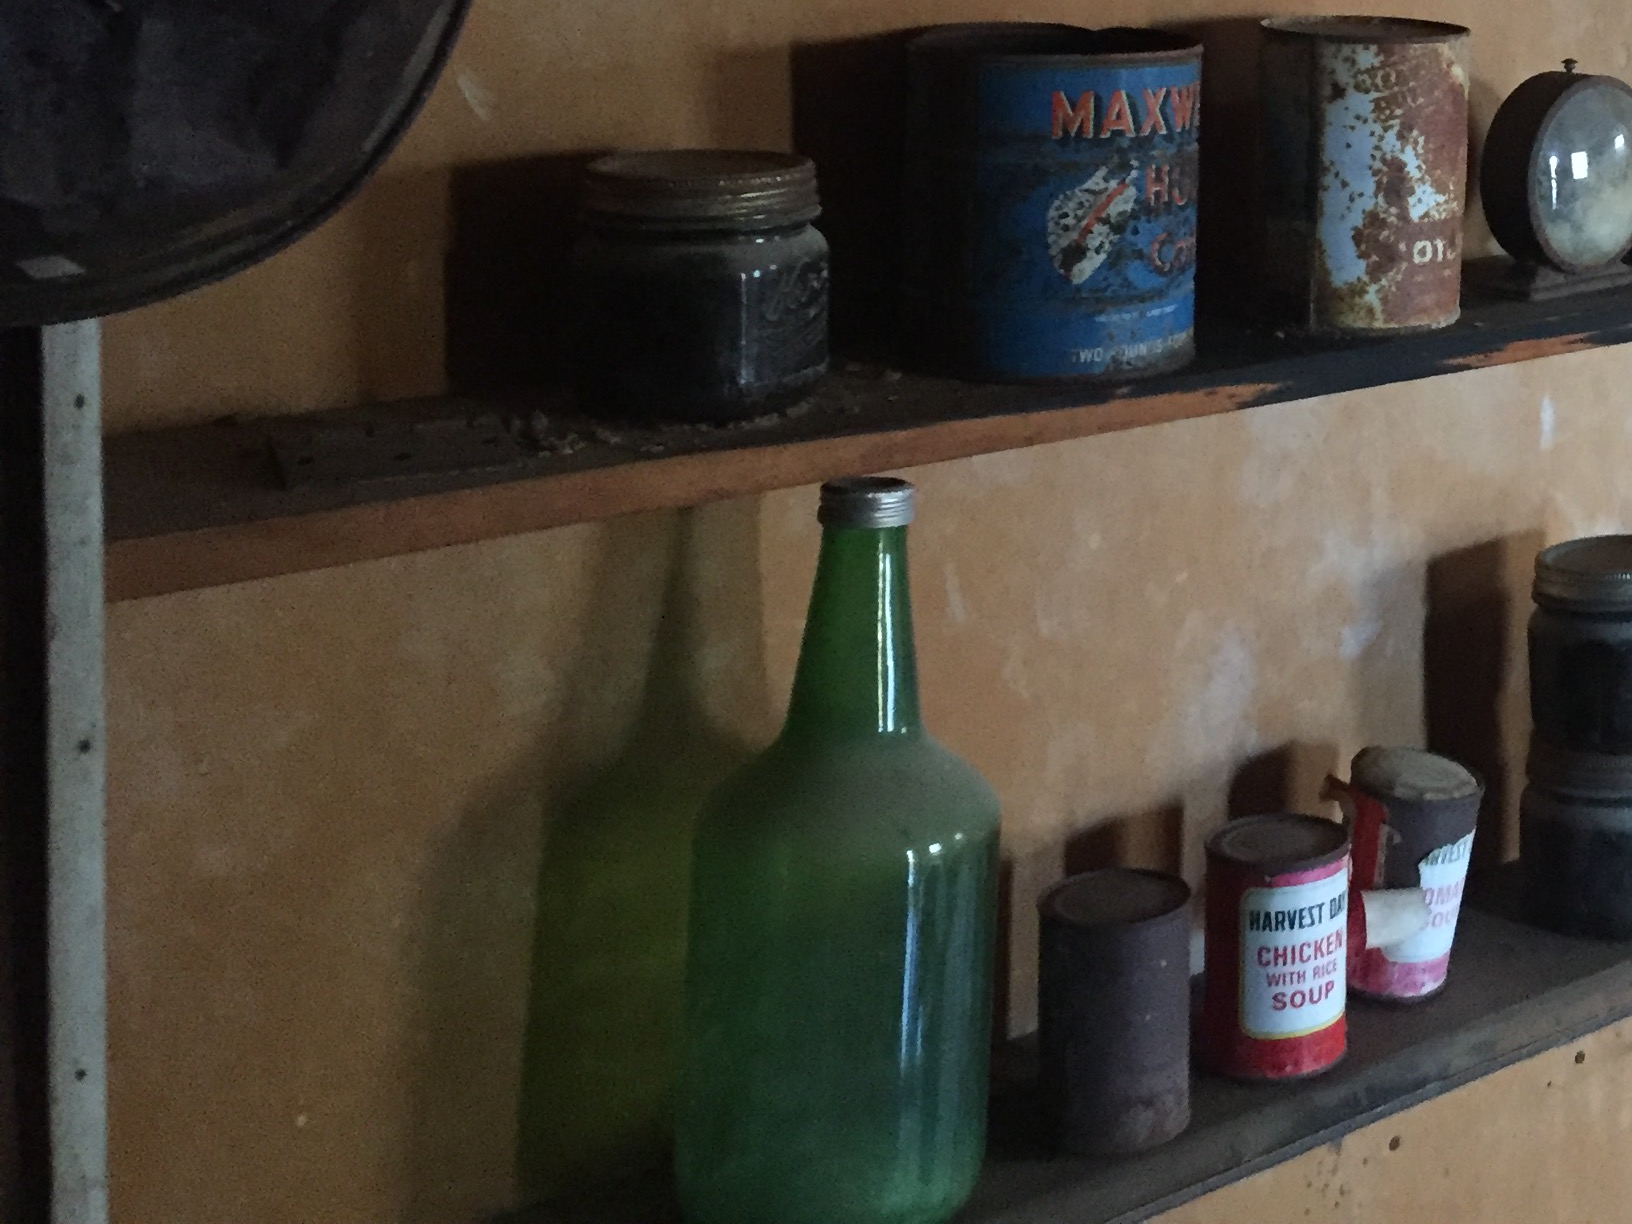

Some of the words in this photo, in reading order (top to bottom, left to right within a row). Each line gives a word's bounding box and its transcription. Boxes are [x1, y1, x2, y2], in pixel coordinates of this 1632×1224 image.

[1050, 82, 1200, 140] MAXW
[1070, 346, 1104, 363] TWO
[1249, 901, 1326, 932] HARVEST
[1257, 928, 1344, 967] CHICKEN
[1266, 969, 1307, 987] WITH
[1312, 957, 1338, 981] RICE
[1271, 979, 1335, 1012] SOUP
